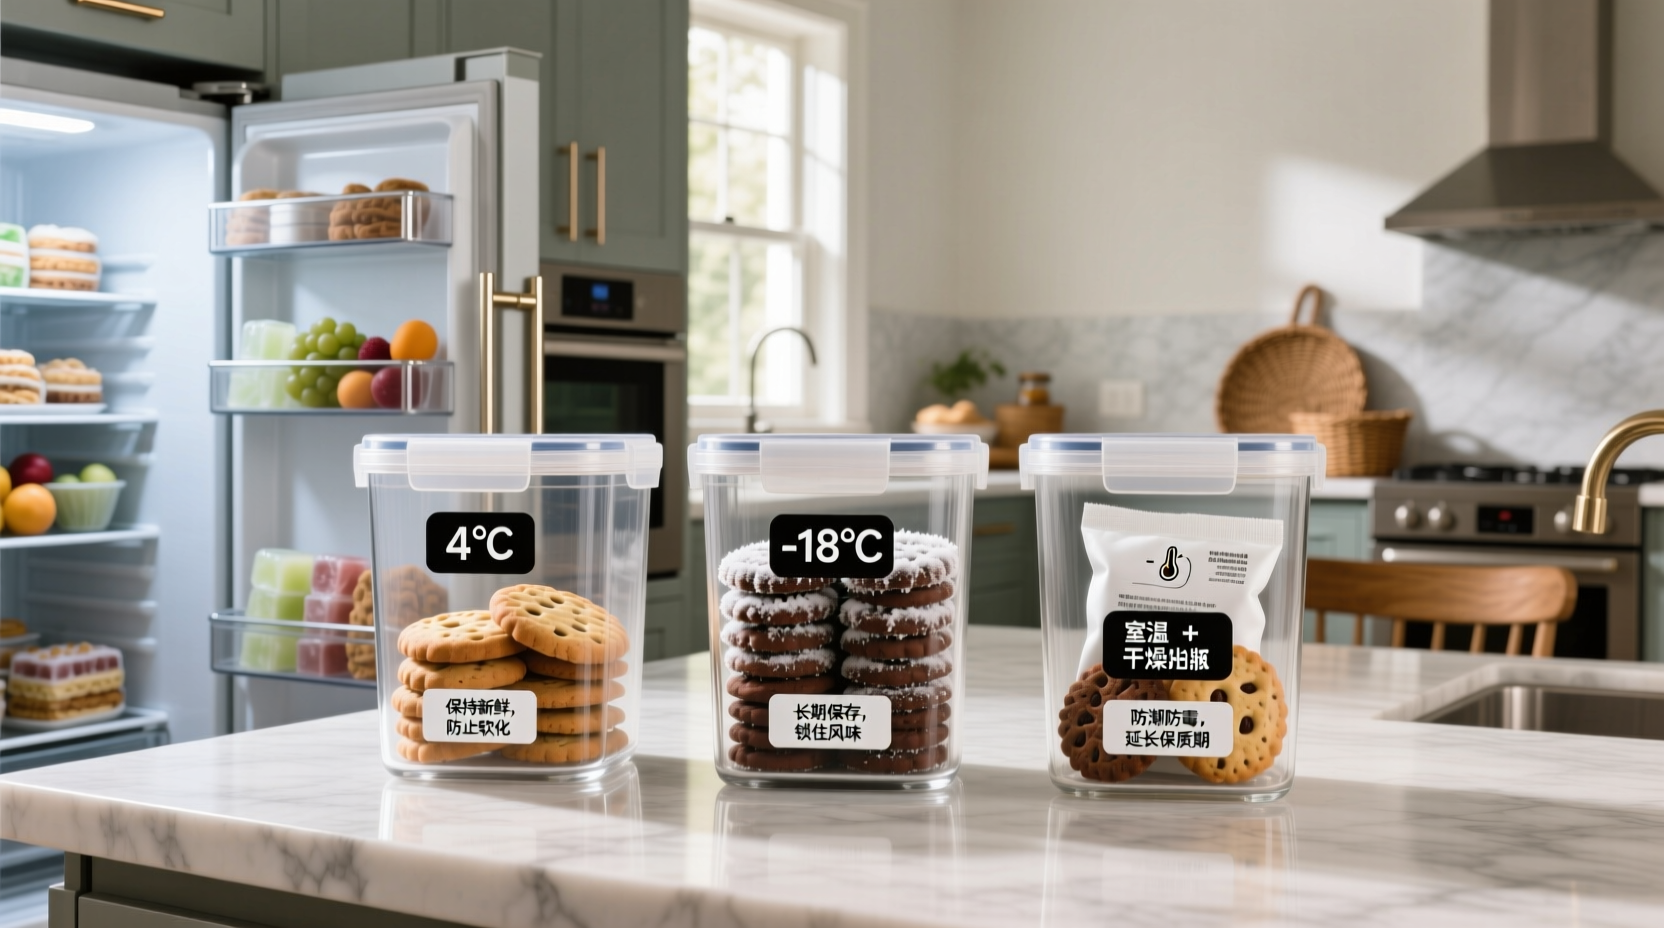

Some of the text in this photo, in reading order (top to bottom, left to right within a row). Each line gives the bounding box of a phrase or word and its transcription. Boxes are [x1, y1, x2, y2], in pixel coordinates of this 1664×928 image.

[1182, 624, 1199, 642] +
[1125, 731, 1210, 749] 延长保质期
